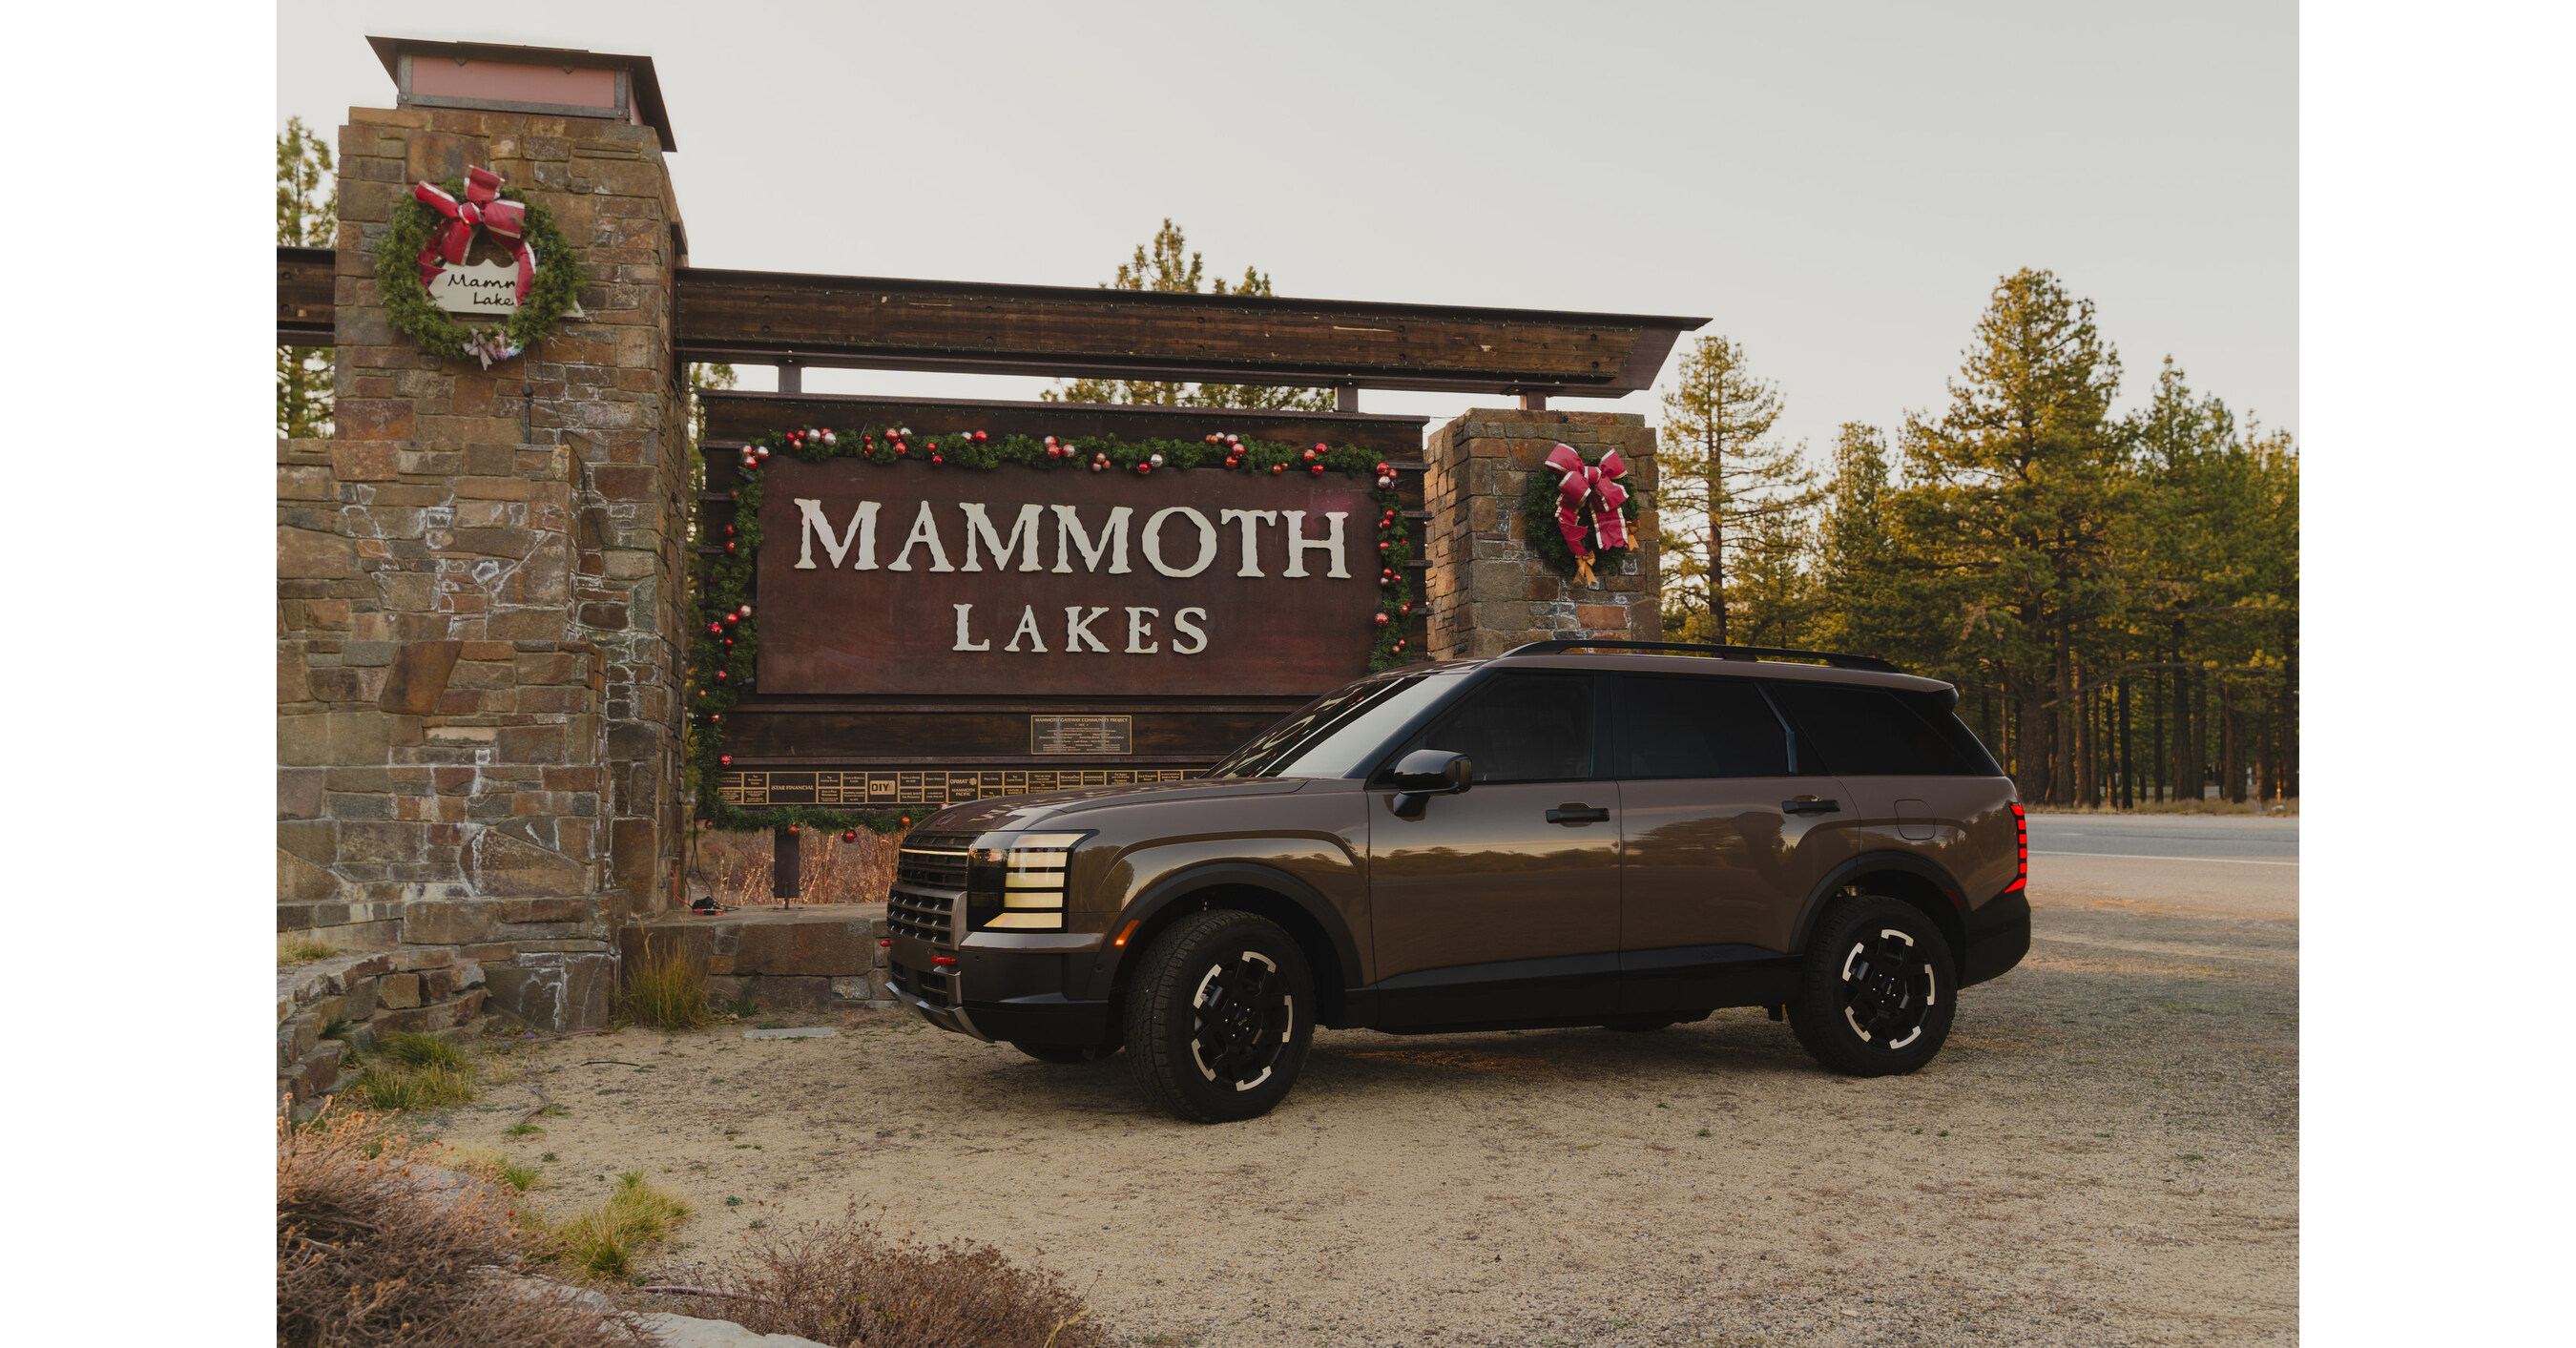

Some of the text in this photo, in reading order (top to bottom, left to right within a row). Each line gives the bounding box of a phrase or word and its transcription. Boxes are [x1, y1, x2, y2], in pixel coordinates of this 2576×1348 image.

[793, 497, 1352, 579] MAMMOTH
[952, 603, 1209, 655] LAKES
[871, 783, 889, 792] DIY
